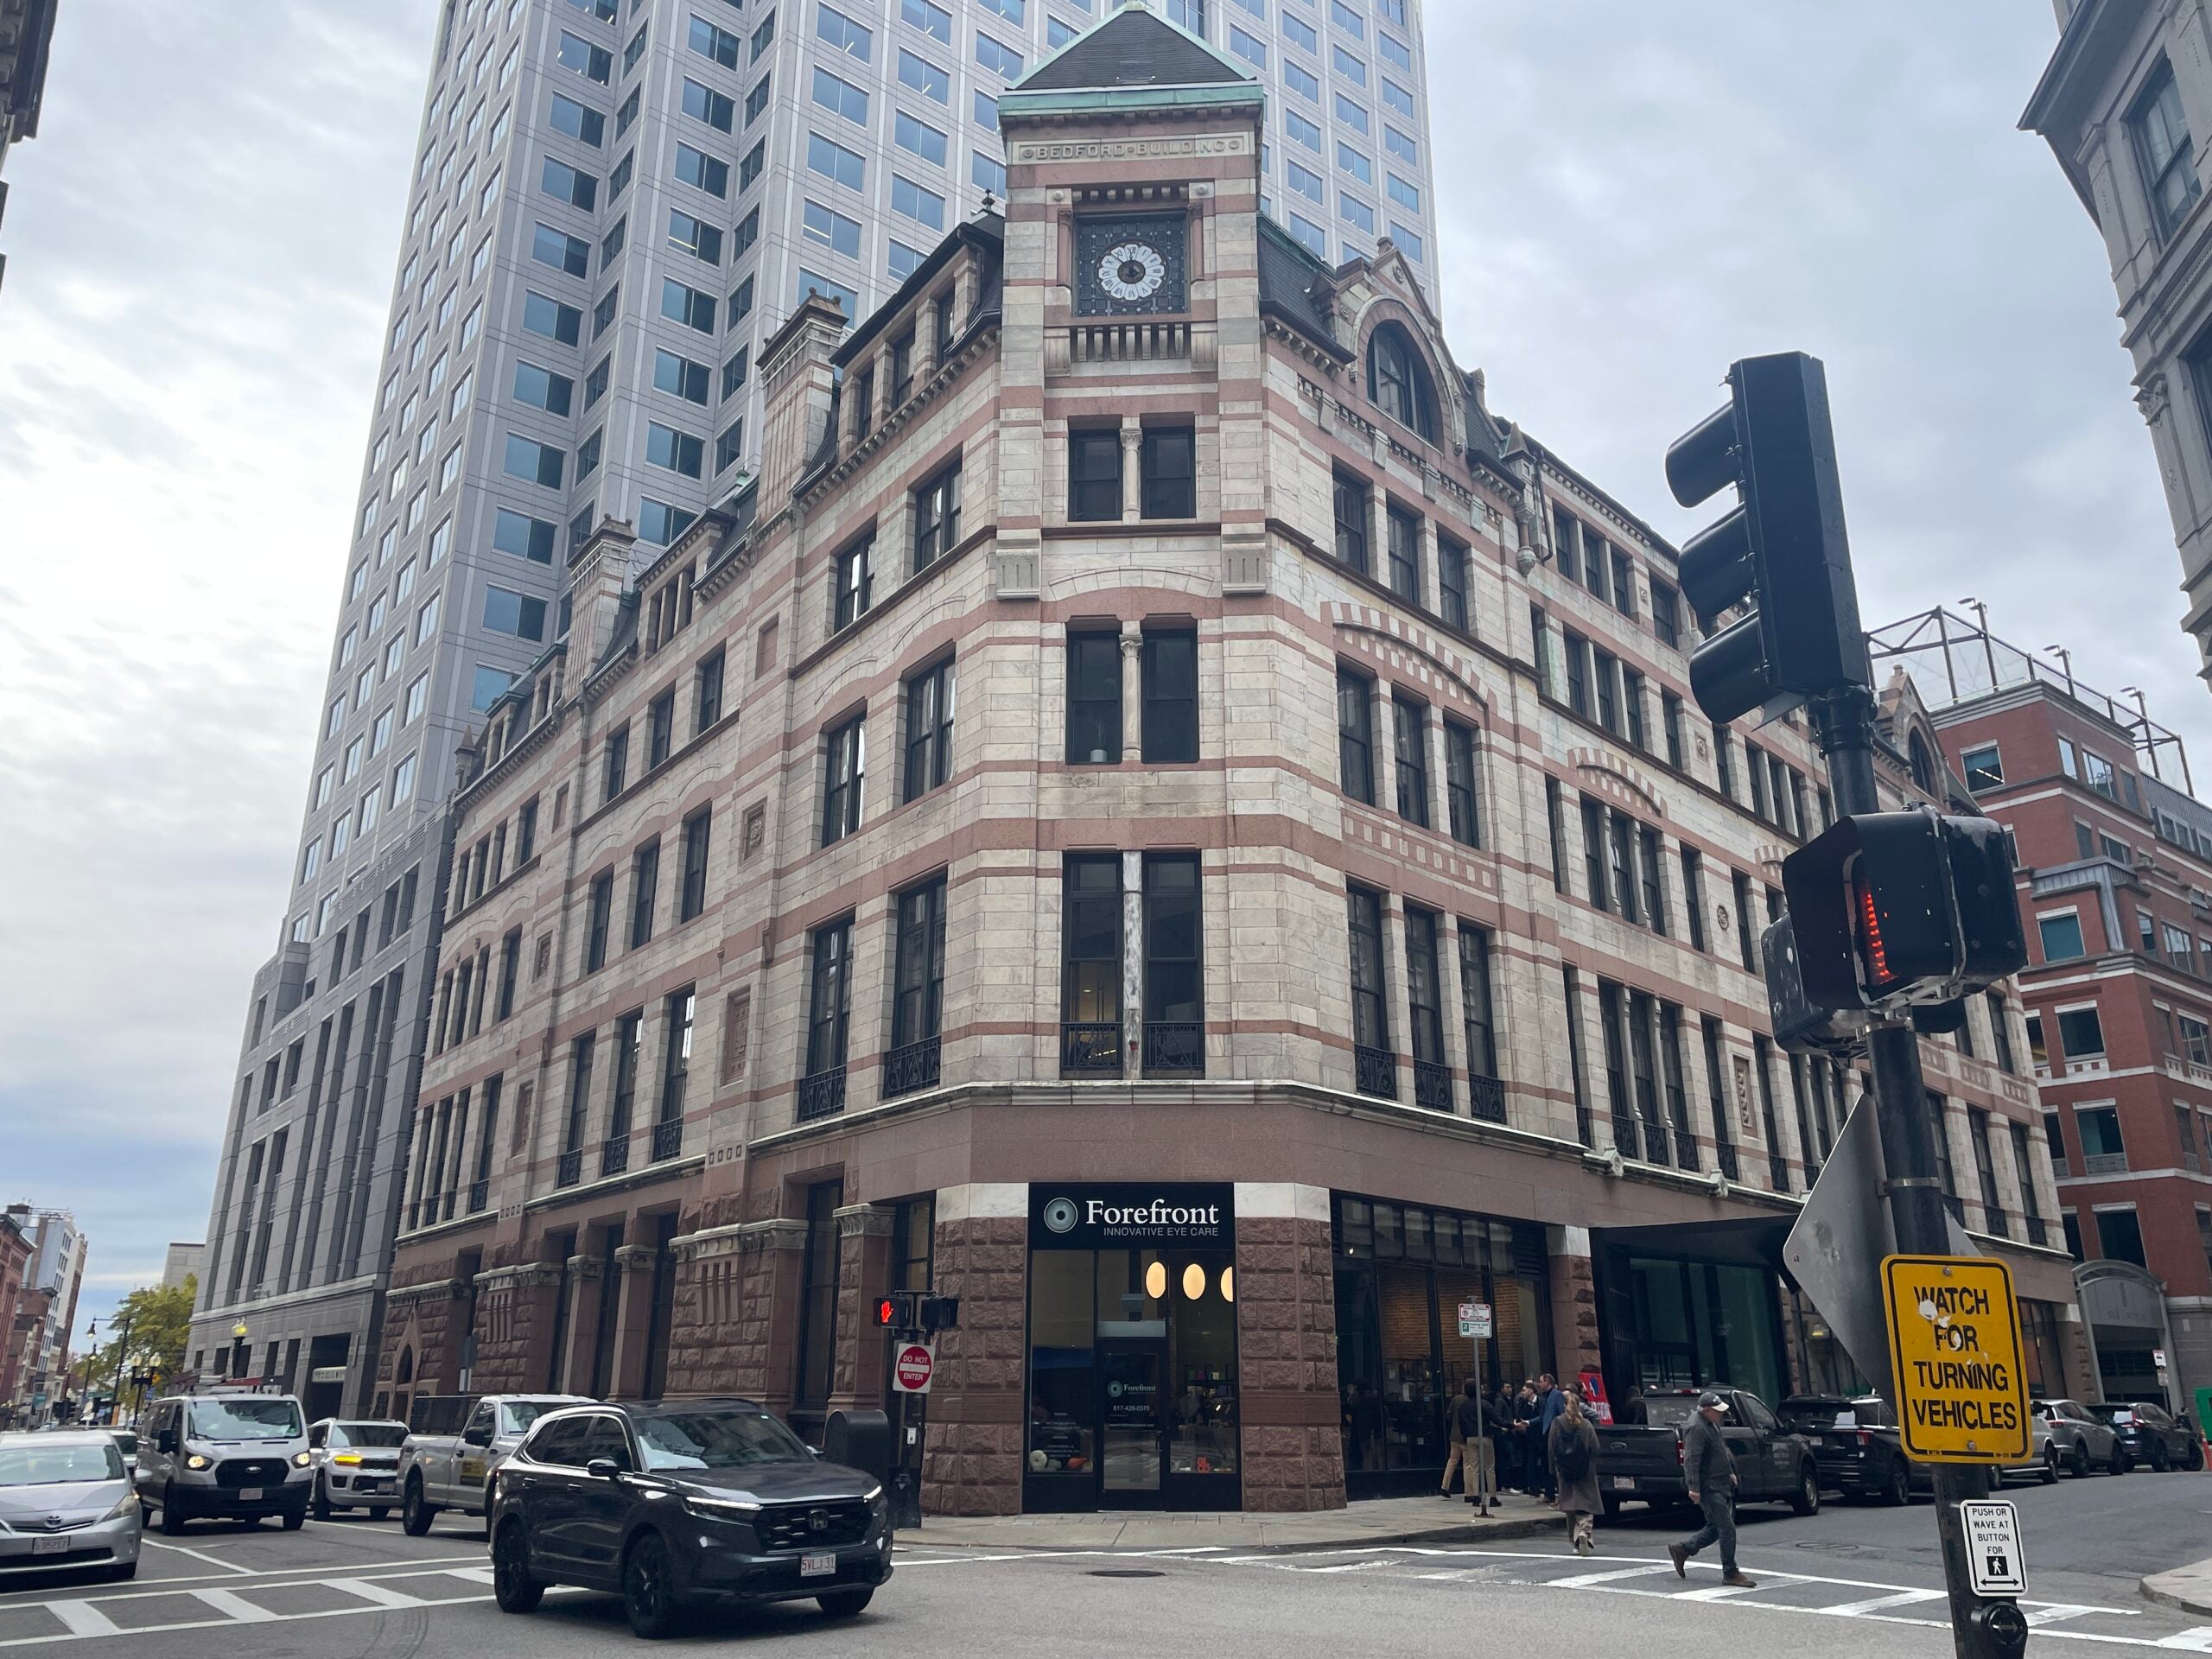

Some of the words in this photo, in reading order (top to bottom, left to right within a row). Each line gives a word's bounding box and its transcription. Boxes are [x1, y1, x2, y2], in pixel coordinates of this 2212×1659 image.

[1036, 143, 1124, 160] BEDFORD
[1137, 140, 1226, 156] BUILDING
[1085, 1198, 1219, 1224] Forefront
[1103, 1227, 1164, 1236] INNOVATIVE
[1166, 1227, 1187, 1236] EYE
[1190, 1227, 1219, 1236] CARE
[1913, 1286, 1990, 1315] WATCH
[1934, 1324, 1980, 1352] FOR
[903, 1372, 924, 1381] ENTER
[1913, 1361, 2009, 1392] TURNING
[1912, 1399, 2018, 1431] VEHICLES
[1972, 1508, 1994, 1516] PUSH
[1995, 1508, 2007, 1516] OR
[1973, 1520, 1997, 1529] WAVE
[1999, 1520, 2009, 1529] AT
[1977, 1533, 2010, 1541] BUTTON
[1986, 1546, 2004, 1554] FOR
